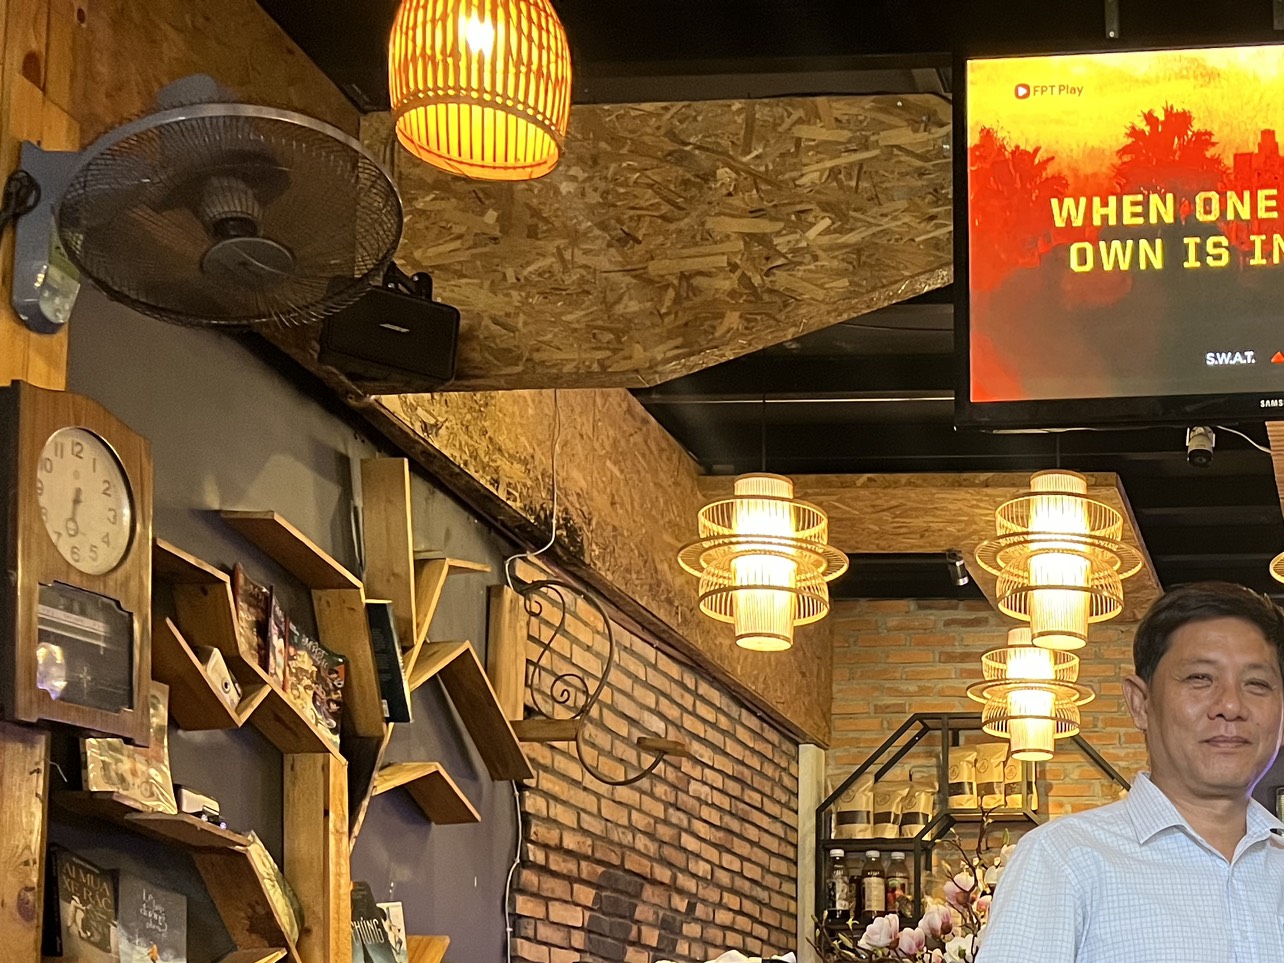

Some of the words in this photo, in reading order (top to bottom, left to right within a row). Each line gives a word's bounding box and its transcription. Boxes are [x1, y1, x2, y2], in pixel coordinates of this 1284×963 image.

[1033, 85, 1056, 96] FPT
[1058, 84, 1084, 97] Play
[1050, 192, 1175, 228] WHEN
[1195, 188, 1278, 222] ONE
[1069, 238, 1164, 273] OWN
[1183, 235, 1230, 269] IS
[1206, 350, 1257, 366] S.W.A.T.
[54, 441, 64, 459] 11
[71, 440, 84, 460] 12
[102, 480, 112, 497] 2
[107, 508, 118, 526] 3
[101, 532, 112, 549] 4
[70, 545, 81, 564] 6
[89, 544, 98, 563] 5
